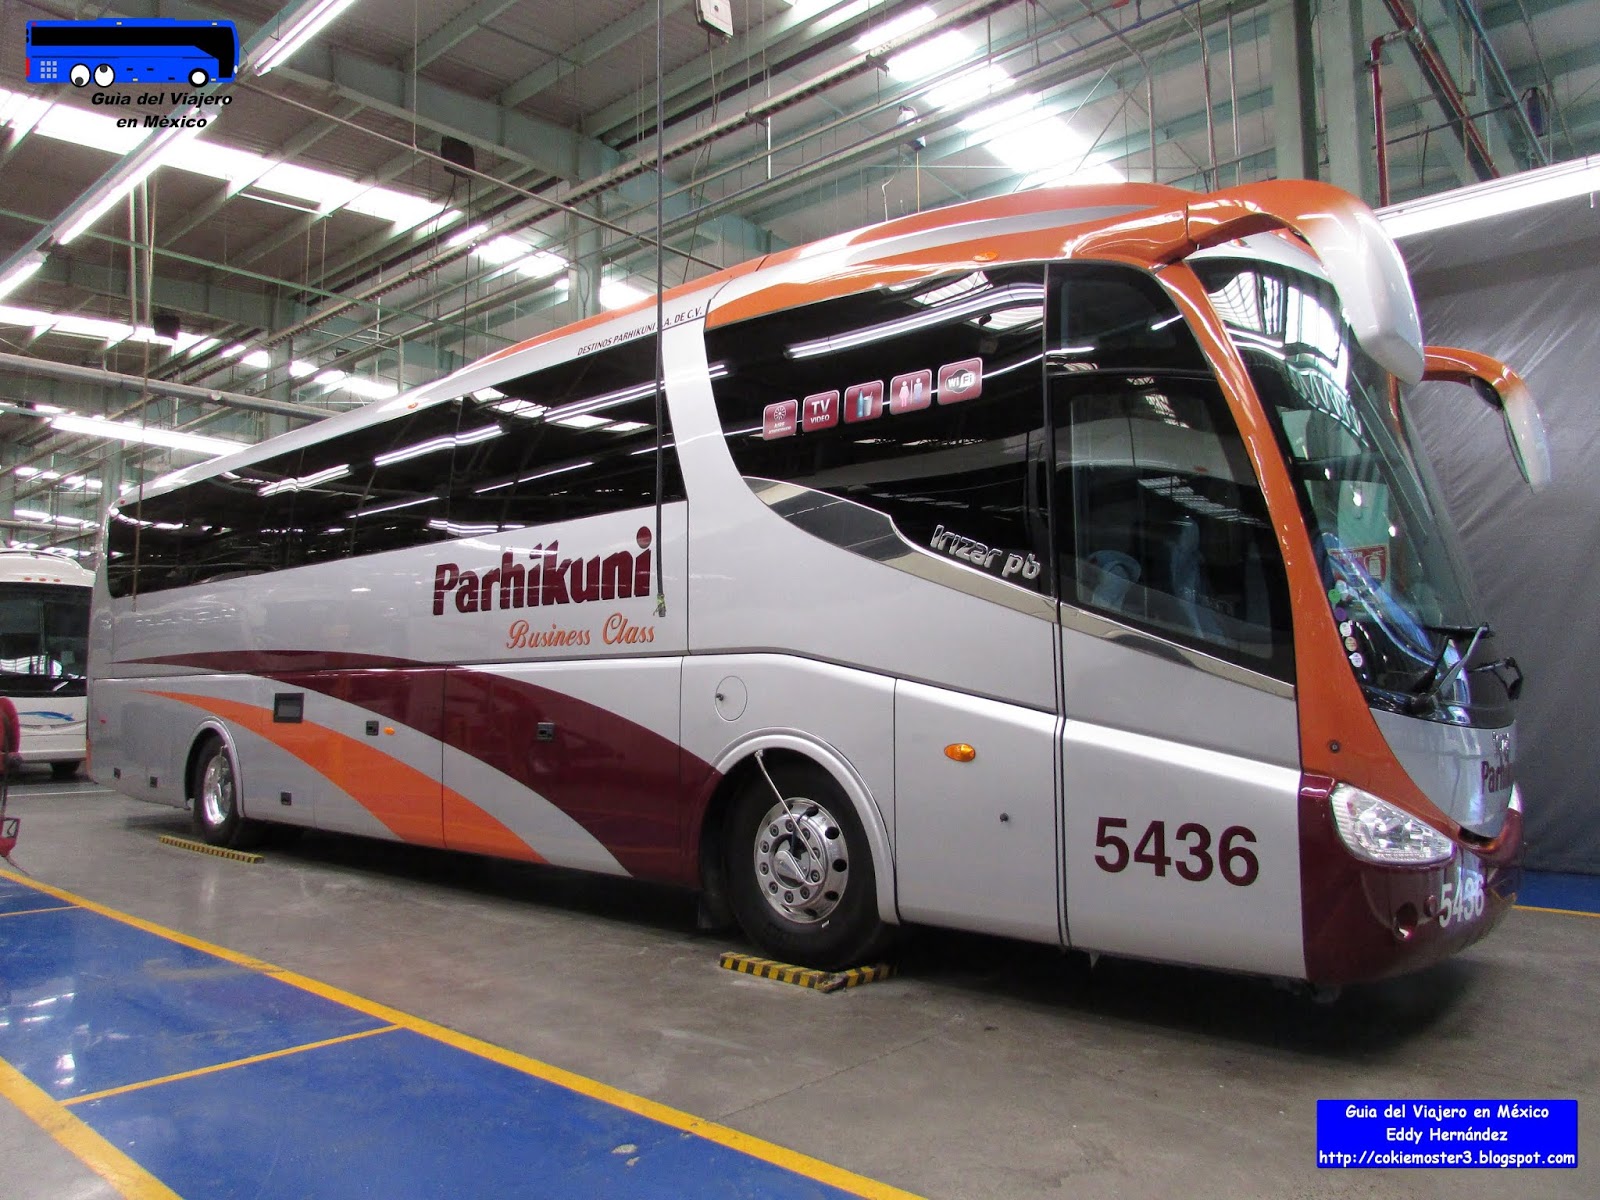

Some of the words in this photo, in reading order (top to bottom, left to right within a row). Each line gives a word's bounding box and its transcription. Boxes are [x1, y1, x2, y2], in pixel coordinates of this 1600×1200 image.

[577, 337, 612, 356] DESTINOS
[613, 322, 655, 344] PARHIKUNI
[674, 314, 685, 324] DE
[687, 307, 703, 319] C.V.
[810, 414, 830, 424] VIDEO
[811, 398, 831, 416] TV
[1001, 553, 1041, 580] pb
[506, 619, 591, 650] Business
[602, 612, 656, 645] Class
[1094, 816, 1259, 887] 5436
[1438, 866, 1485, 928] 5436
